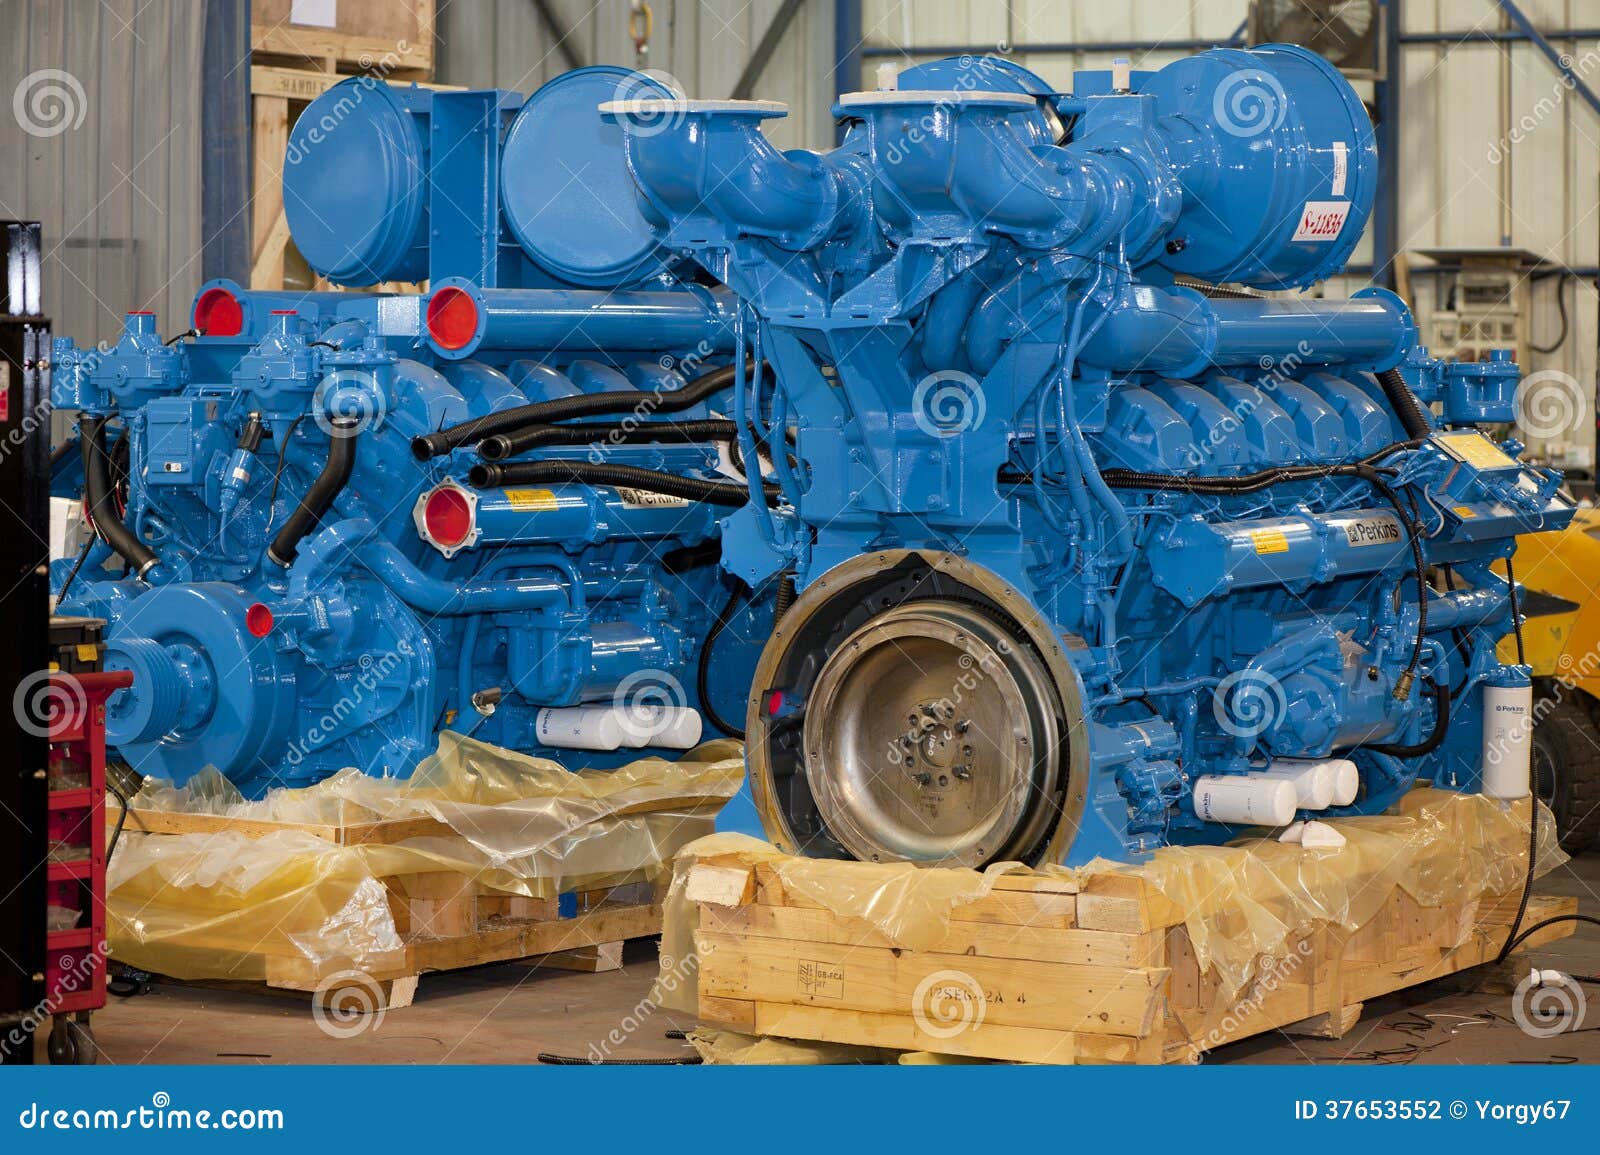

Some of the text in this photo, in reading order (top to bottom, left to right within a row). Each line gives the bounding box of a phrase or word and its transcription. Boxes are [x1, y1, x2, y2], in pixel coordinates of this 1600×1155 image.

[1299, 211, 1344, 235] S-11836
[1356, 521, 1399, 541] Perkins
[1017, 992, 1026, 1004] 4
